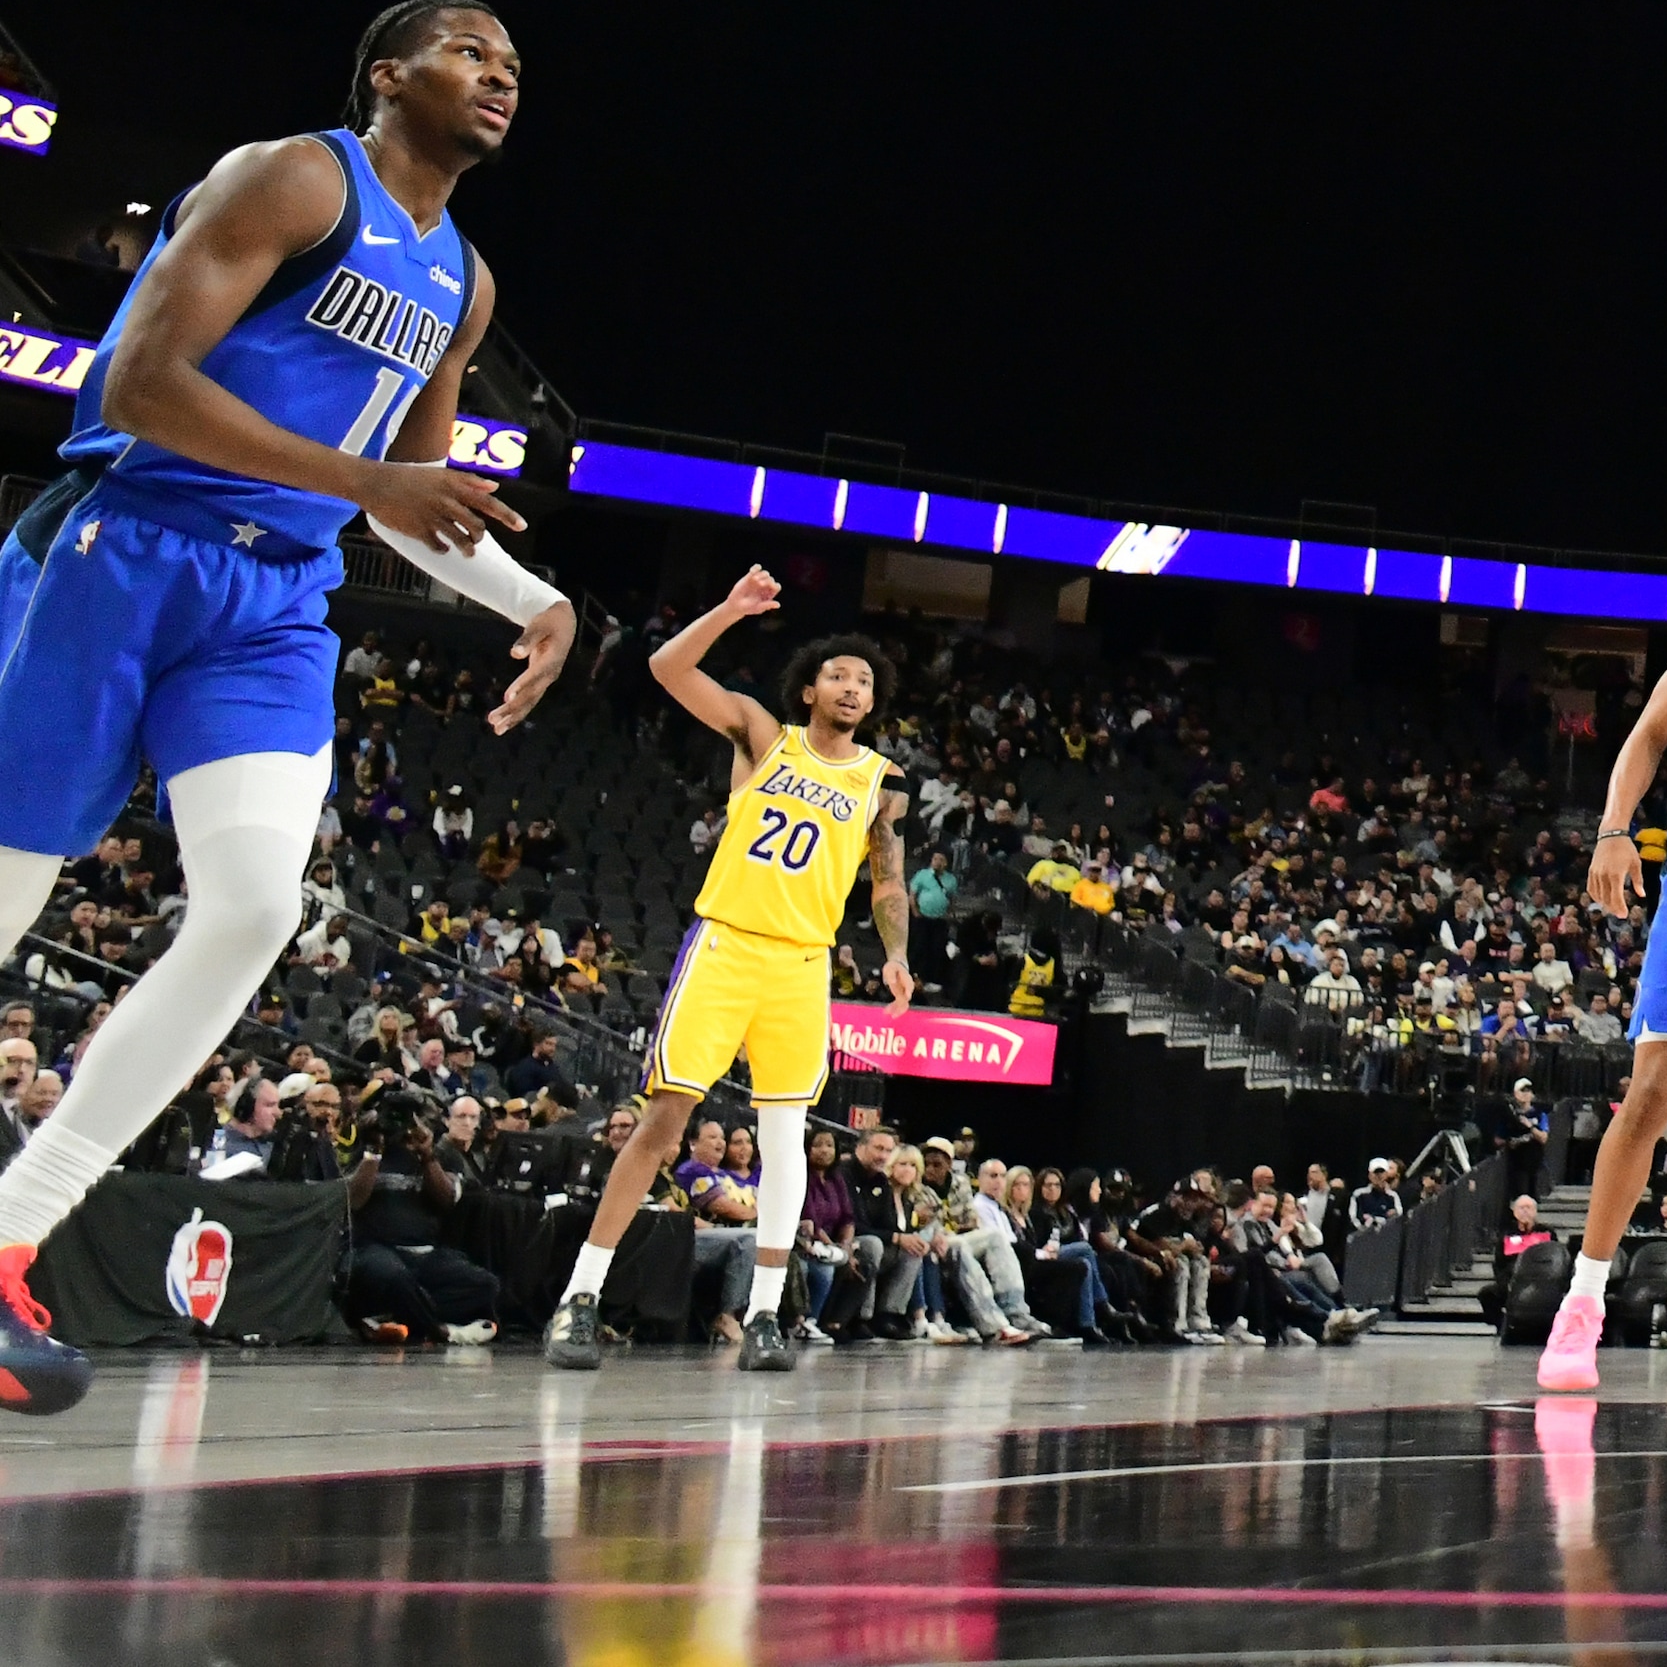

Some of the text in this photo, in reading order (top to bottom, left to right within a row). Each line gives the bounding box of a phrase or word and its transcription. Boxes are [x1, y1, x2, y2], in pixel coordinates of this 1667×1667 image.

[428, 264, 462, 296] chime
[305, 265, 453, 379] DALLAS
[338, 366, 422, 461] 1
[754, 763, 858, 822] LAKERS
[747, 806, 820, 873] 20
[831, 1022, 1001, 1065] Mobile ARENA
